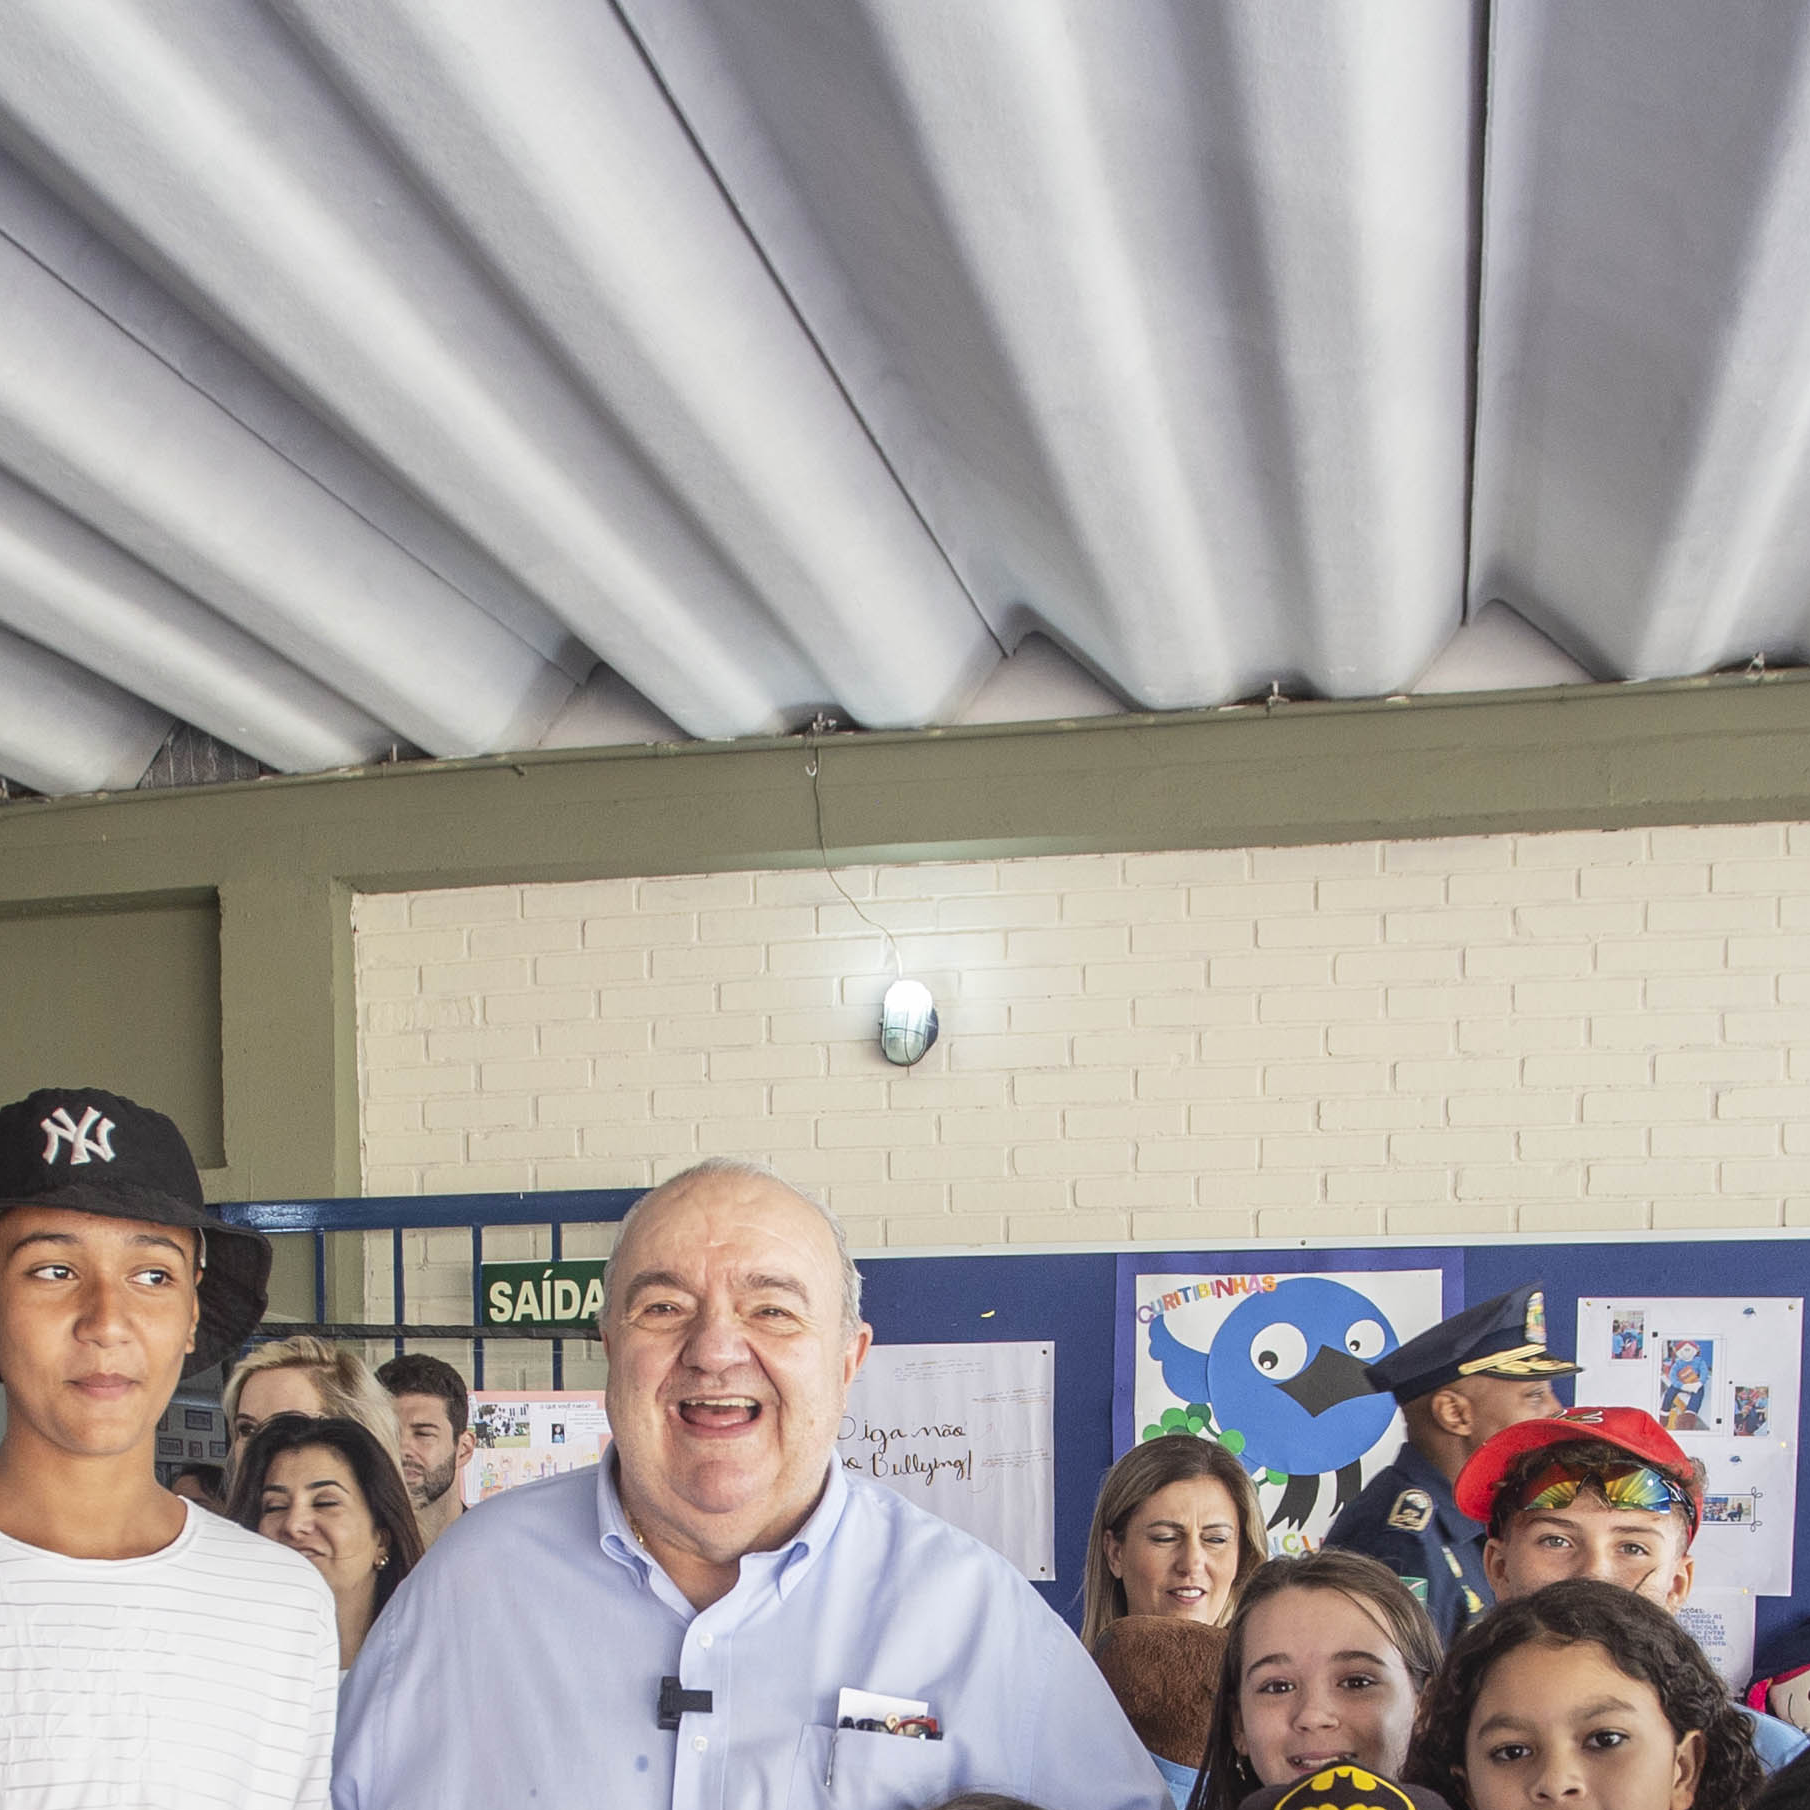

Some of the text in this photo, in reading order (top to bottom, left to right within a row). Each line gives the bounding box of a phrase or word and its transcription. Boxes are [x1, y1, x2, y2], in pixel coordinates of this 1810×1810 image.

[40, 1106, 116, 1165] NY
[489, 1268, 605, 1323] SAÍDA
[1138, 1274, 1277, 1324] CURITIBINHAS
[911, 1422, 967, 1438] não
[871, 1450, 972, 1486] Bullying!
